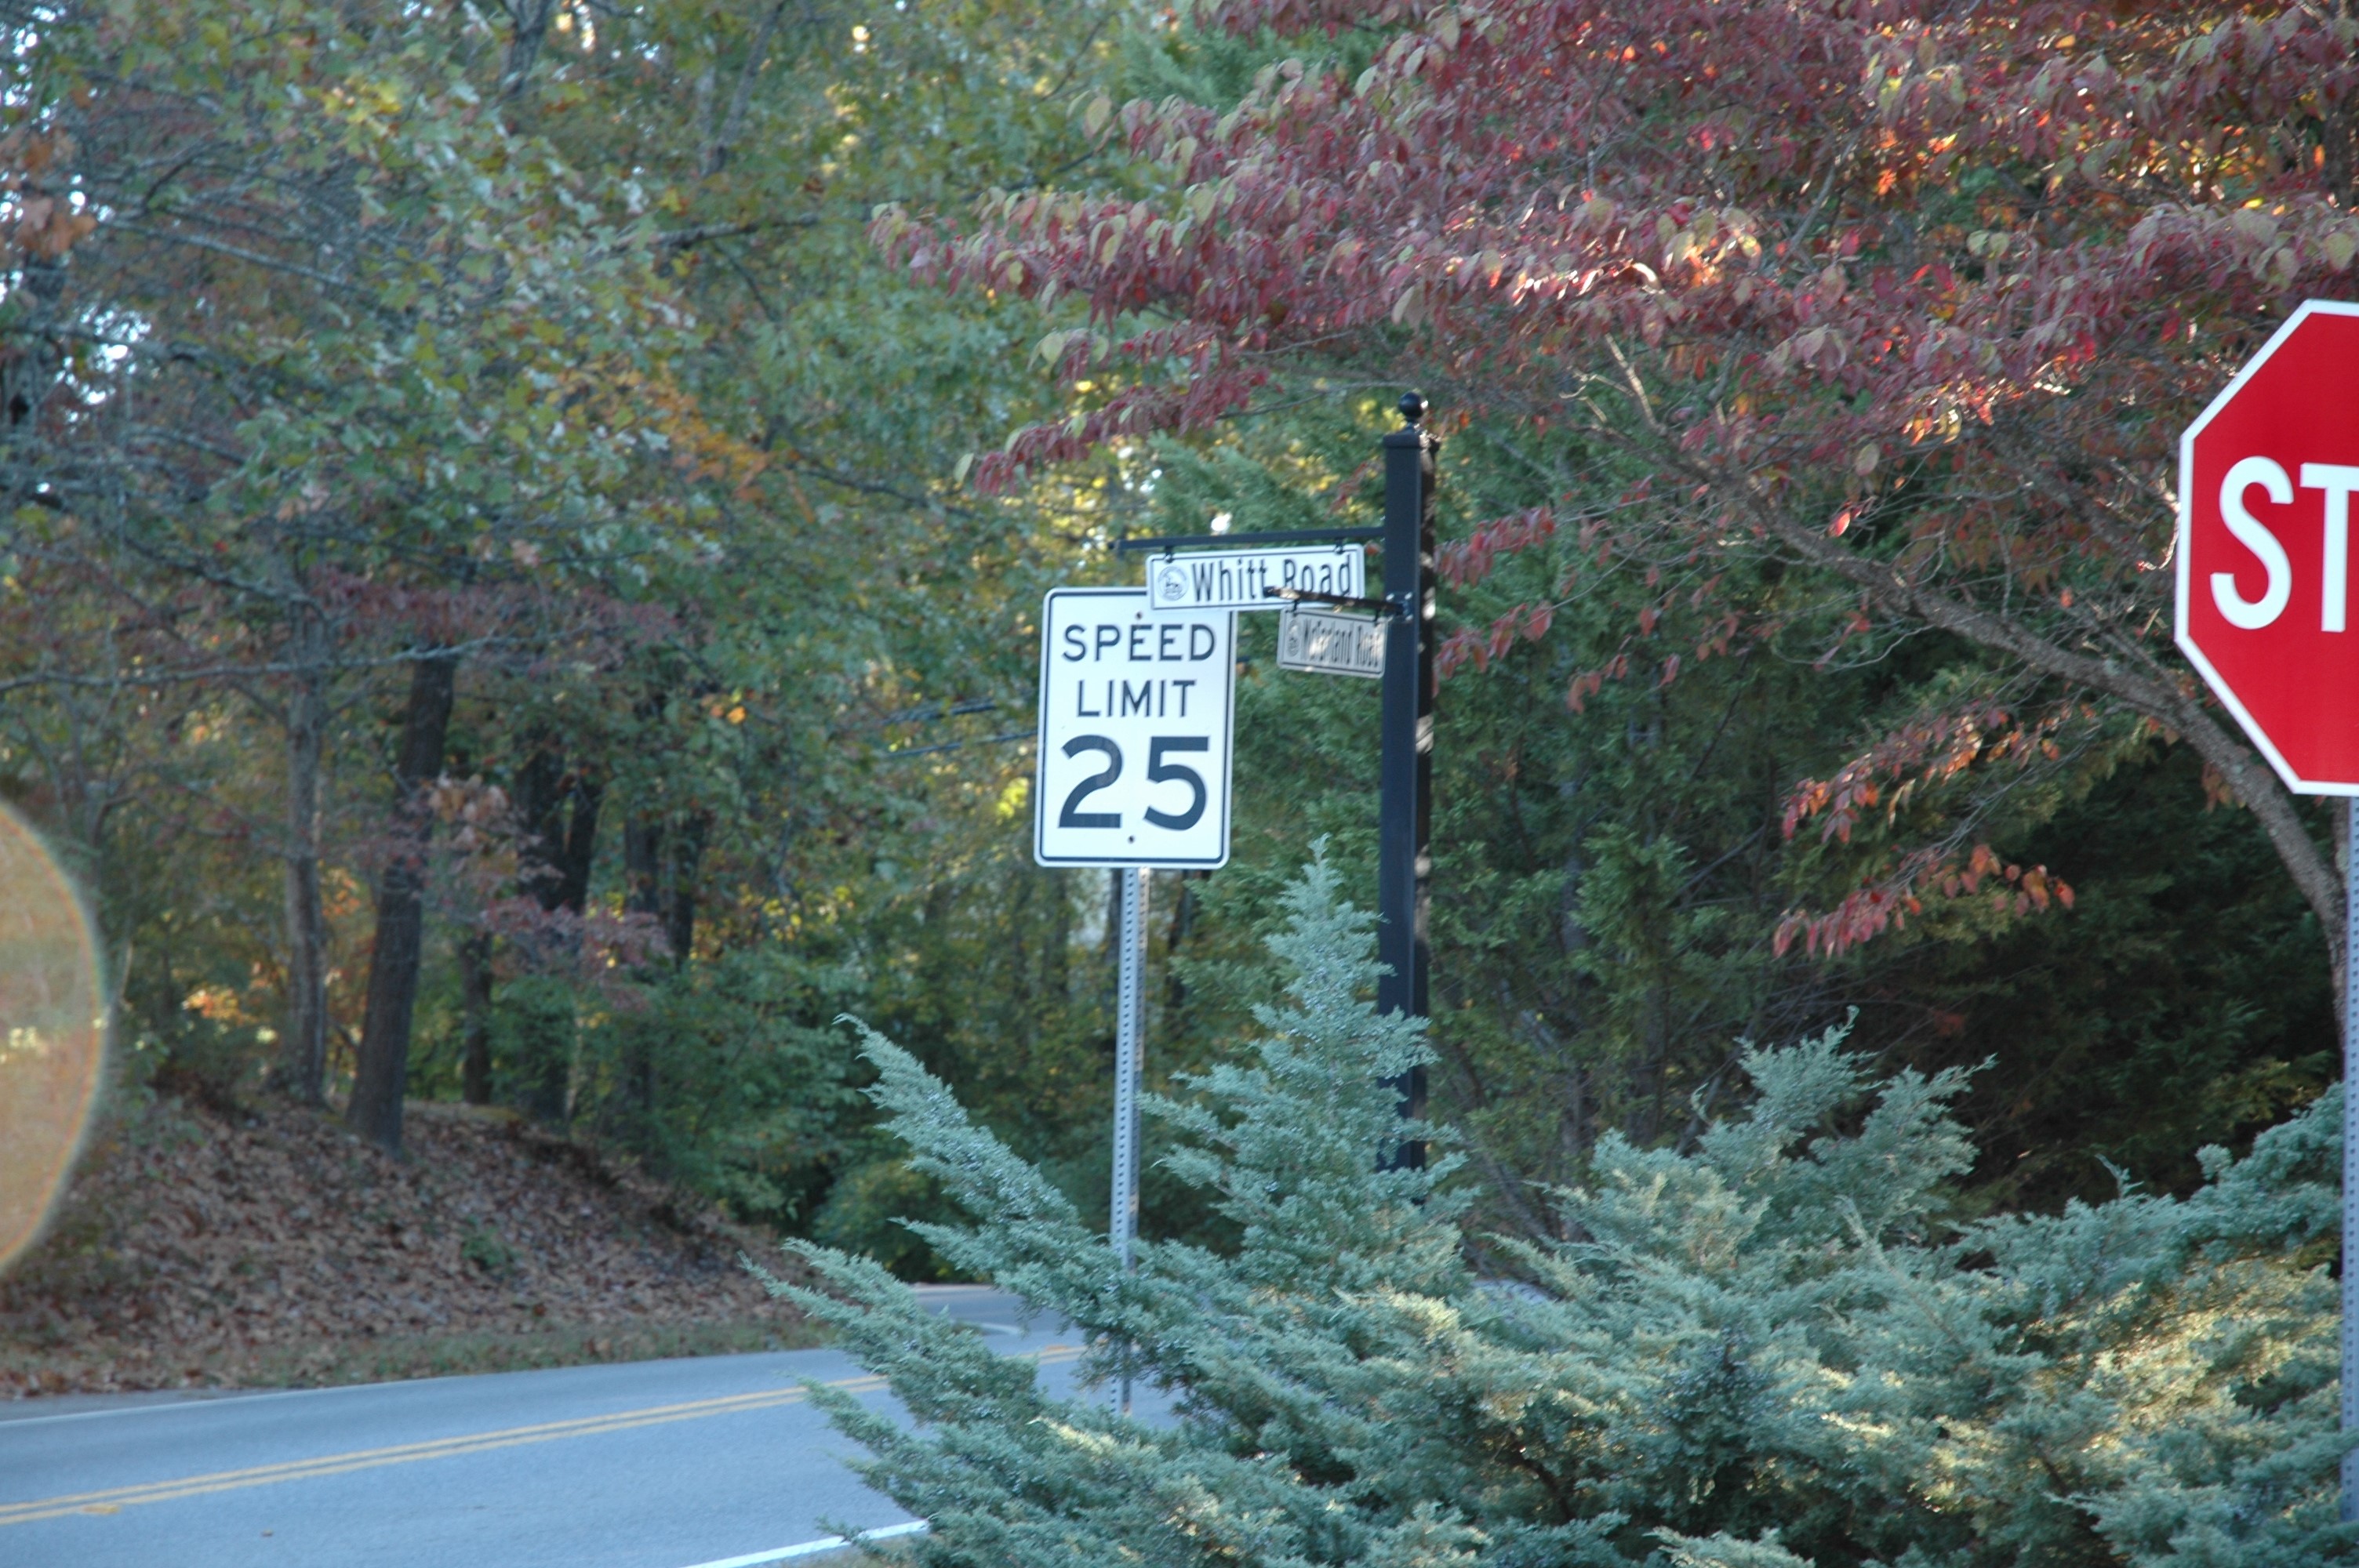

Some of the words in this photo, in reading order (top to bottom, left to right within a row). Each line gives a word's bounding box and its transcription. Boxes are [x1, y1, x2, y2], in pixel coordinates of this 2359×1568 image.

[1191, 558, 1267, 602] Whitt
[1283, 554, 1351, 597] Road
[1061, 623, 1216, 662] SPEED
[1076, 679, 1197, 717] LIMIT
[1056, 734, 1210, 831] 25
